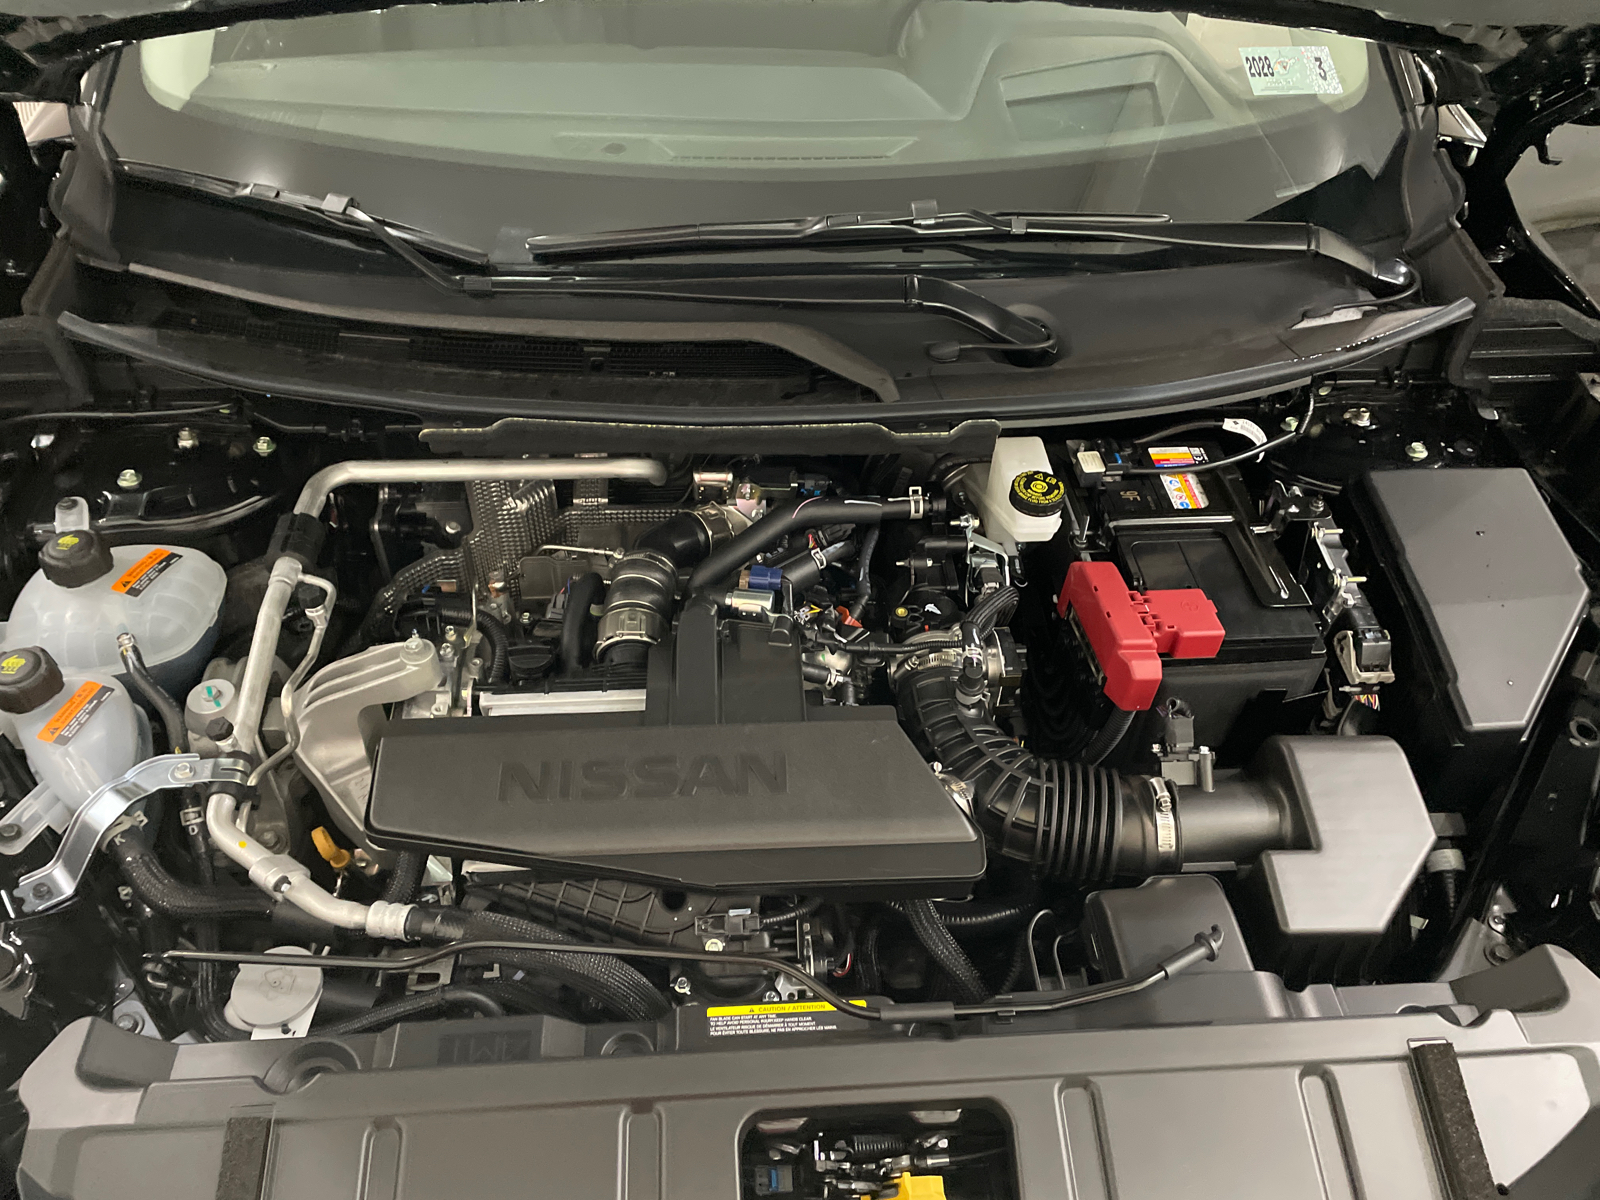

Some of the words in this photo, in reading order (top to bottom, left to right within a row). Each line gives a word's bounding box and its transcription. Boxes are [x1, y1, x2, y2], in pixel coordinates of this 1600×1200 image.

[1245, 56, 1274, 77] 2028
[1314, 57, 1327, 81] 3
[498, 754, 788, 802] NISSAN
